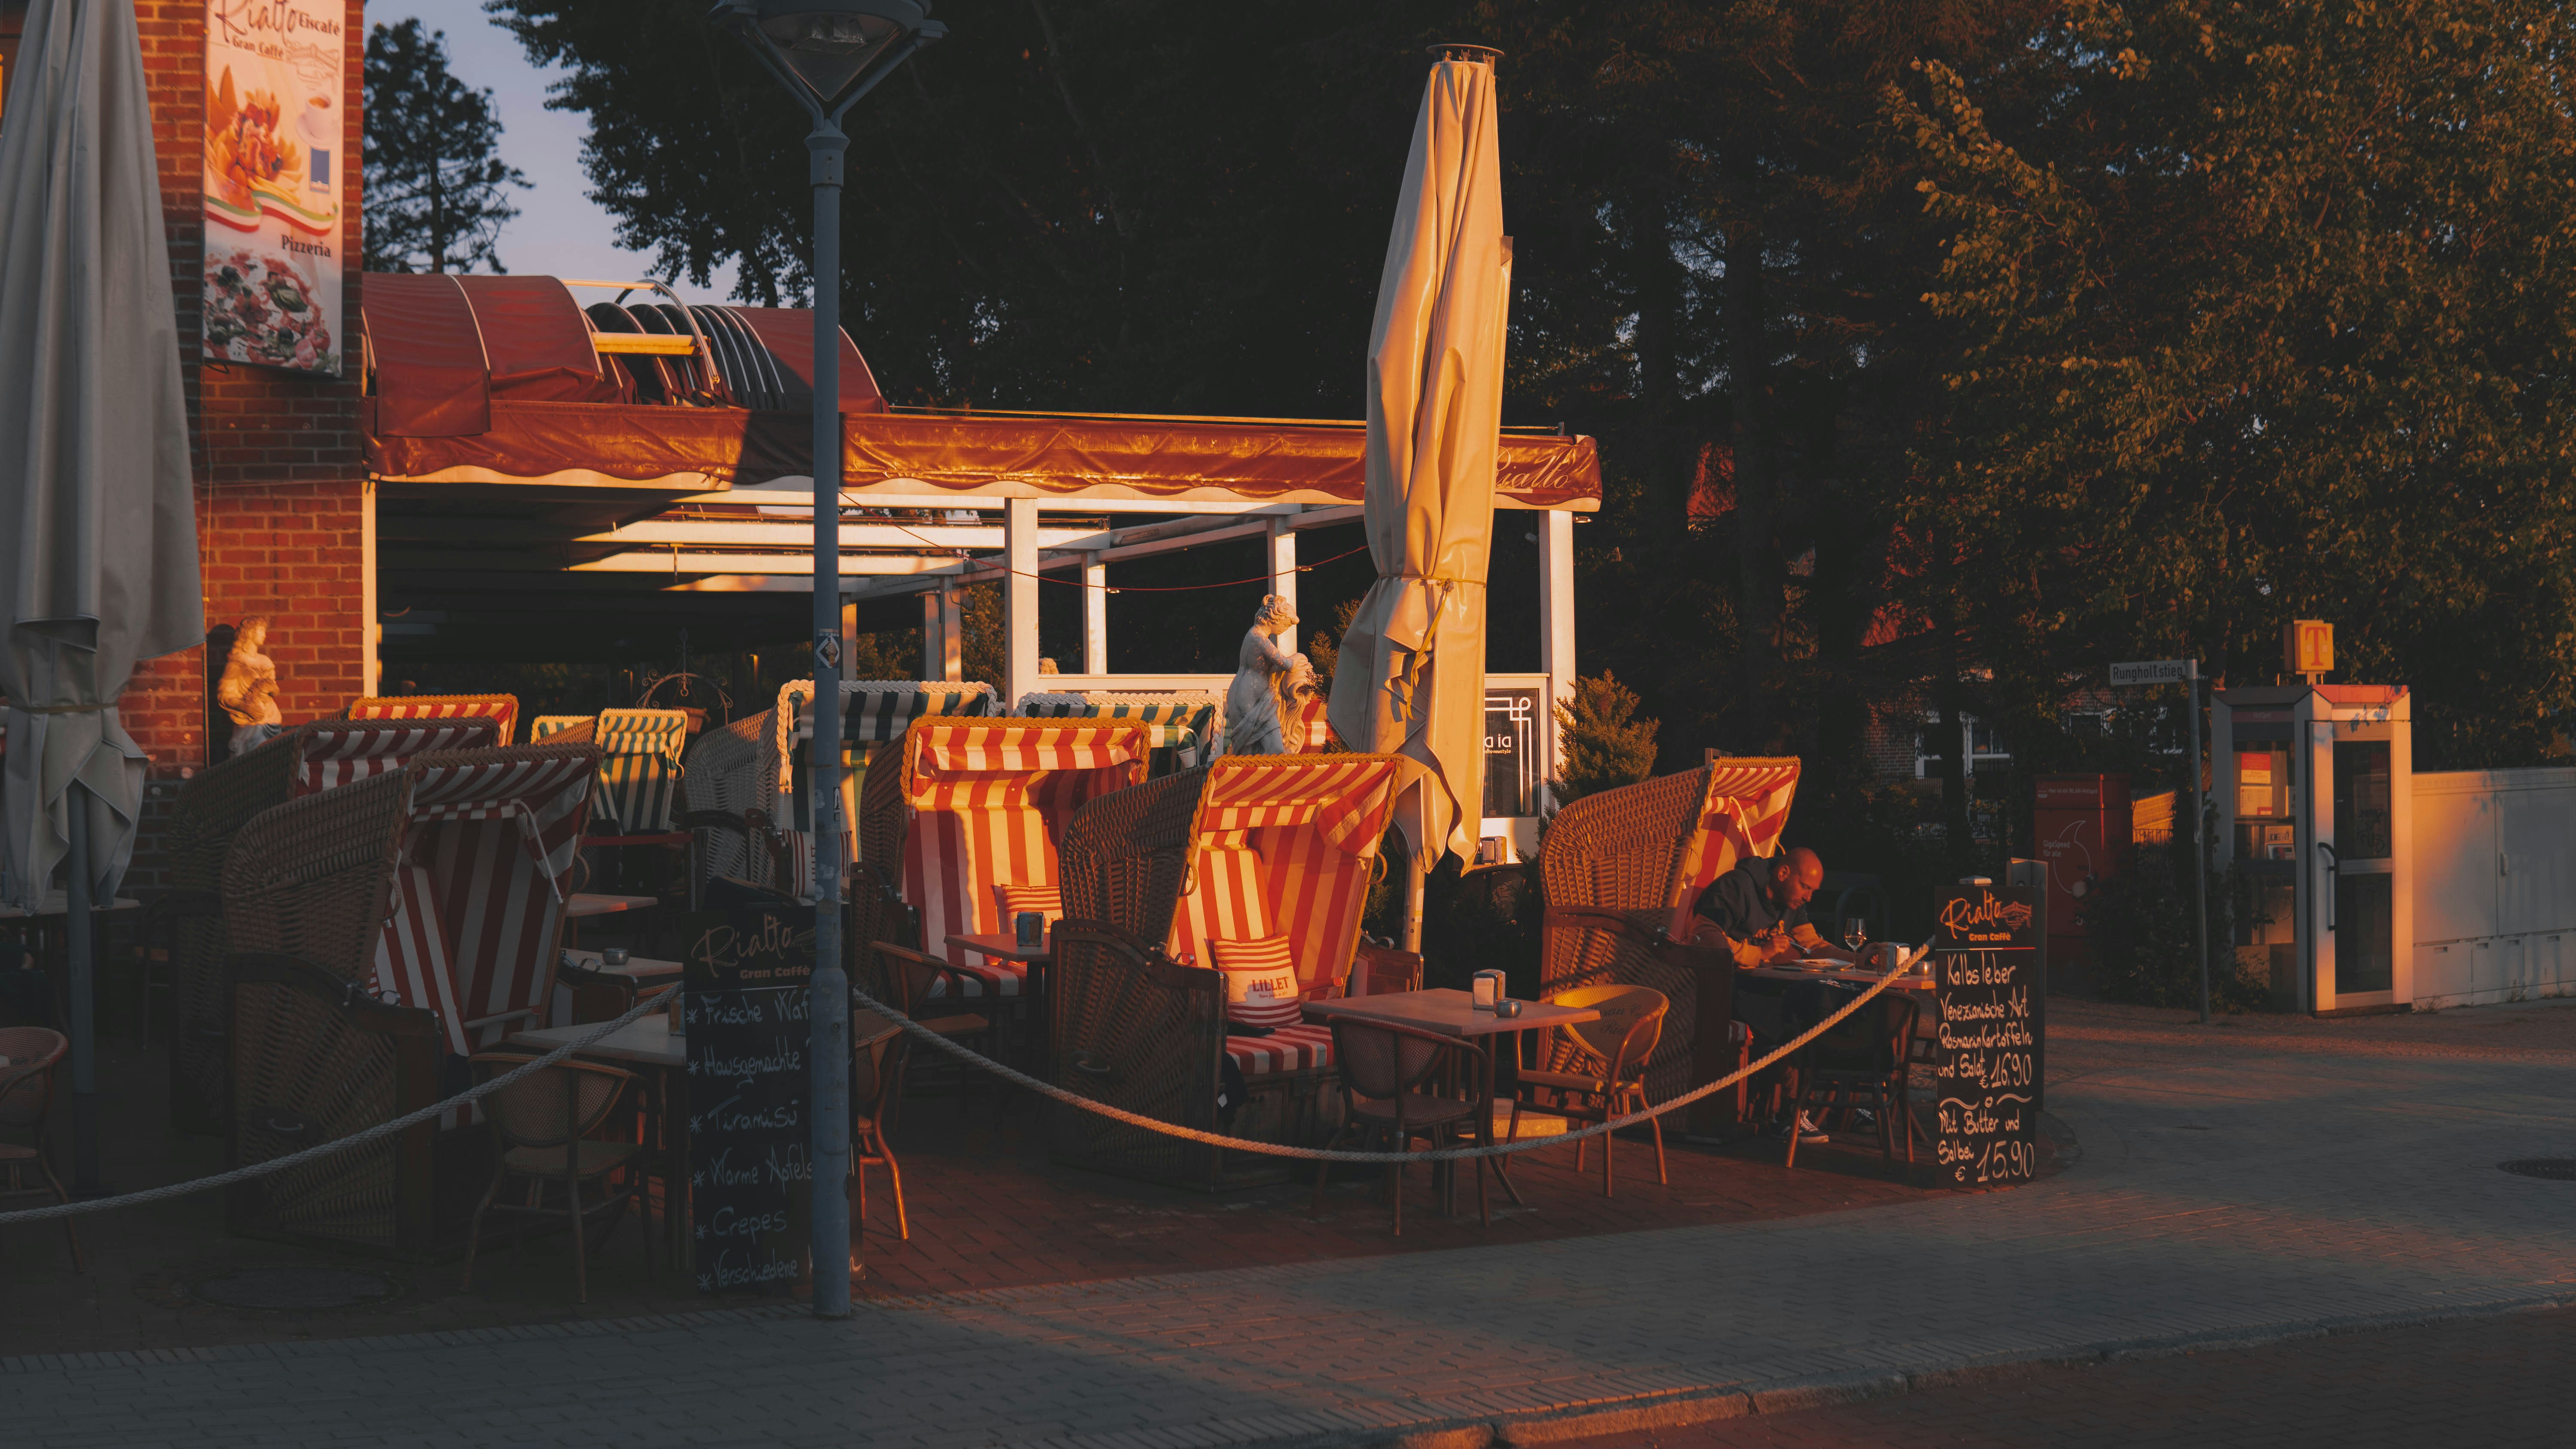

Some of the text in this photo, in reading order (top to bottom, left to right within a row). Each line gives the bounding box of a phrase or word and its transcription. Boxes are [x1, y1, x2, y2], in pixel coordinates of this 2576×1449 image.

[299, 10, 340, 36] Eiscafé
[232, 34, 256, 52] Gran
[281, 233, 331, 258] Pizzeria
[2306, 627, 2327, 666] T
[2113, 664, 2183, 682] Rungholtstieg
[2043, 840, 2070, 849] GigaSpeed
[1940, 888, 2002, 940] Rialto
[691, 913, 794, 978] Rialto
[1968, 932, 2011, 942] Gran Caffè
[739, 965, 811, 979] Gran Caffè
[1252, 976, 1288, 991] LILLET
[700, 988, 811, 1025] Frische Waf
[1940, 984, 2030, 1022] Venezianische Art
[704, 1035, 801, 1089] Hausgemachte
[1937, 1047, 1986, 1078] und Salat
[1978, 1074, 1989, 1089] €
[1938, 1108, 2020, 1135] Mit Butter und
[1938, 1138, 1975, 1165] Salbei
[708, 1146, 759, 1188] Warme
[1954, 1165, 1966, 1182] €
[713, 1206, 787, 1244] Crepes
[713, 1248, 798, 1288] Verschiedene
